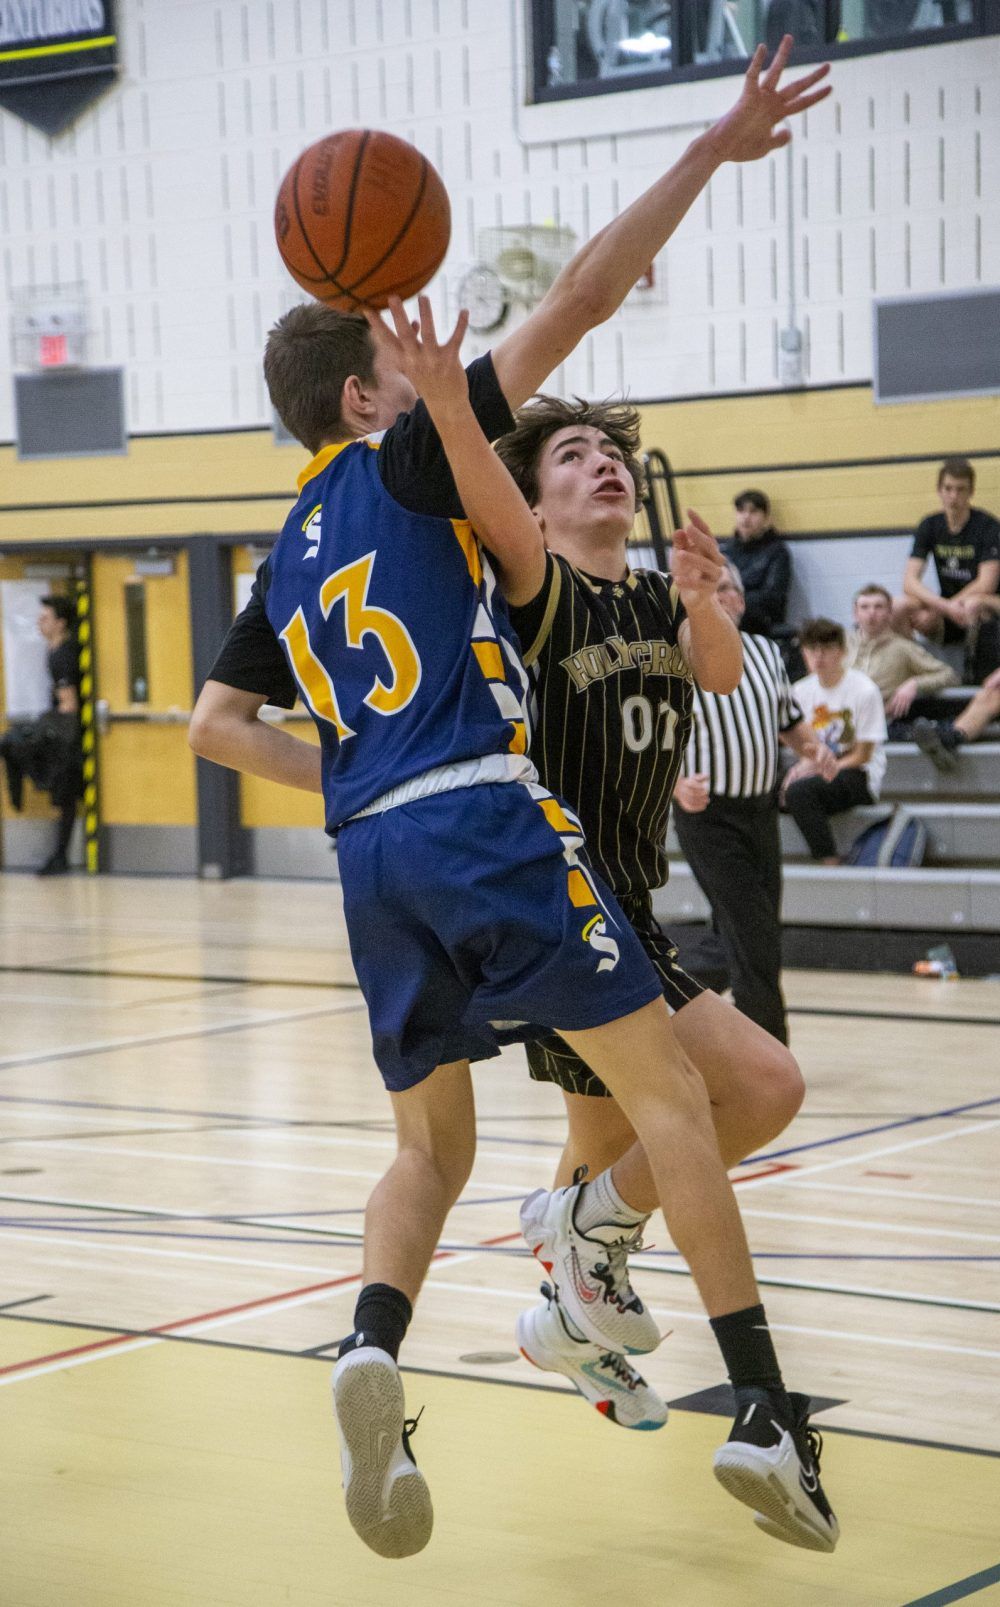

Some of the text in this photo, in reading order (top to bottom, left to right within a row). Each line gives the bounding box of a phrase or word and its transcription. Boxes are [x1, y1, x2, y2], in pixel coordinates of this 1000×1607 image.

[278, 549, 422, 745] 13
[558, 635, 695, 694] HOLY CRO
[622, 694, 679, 752] 01
